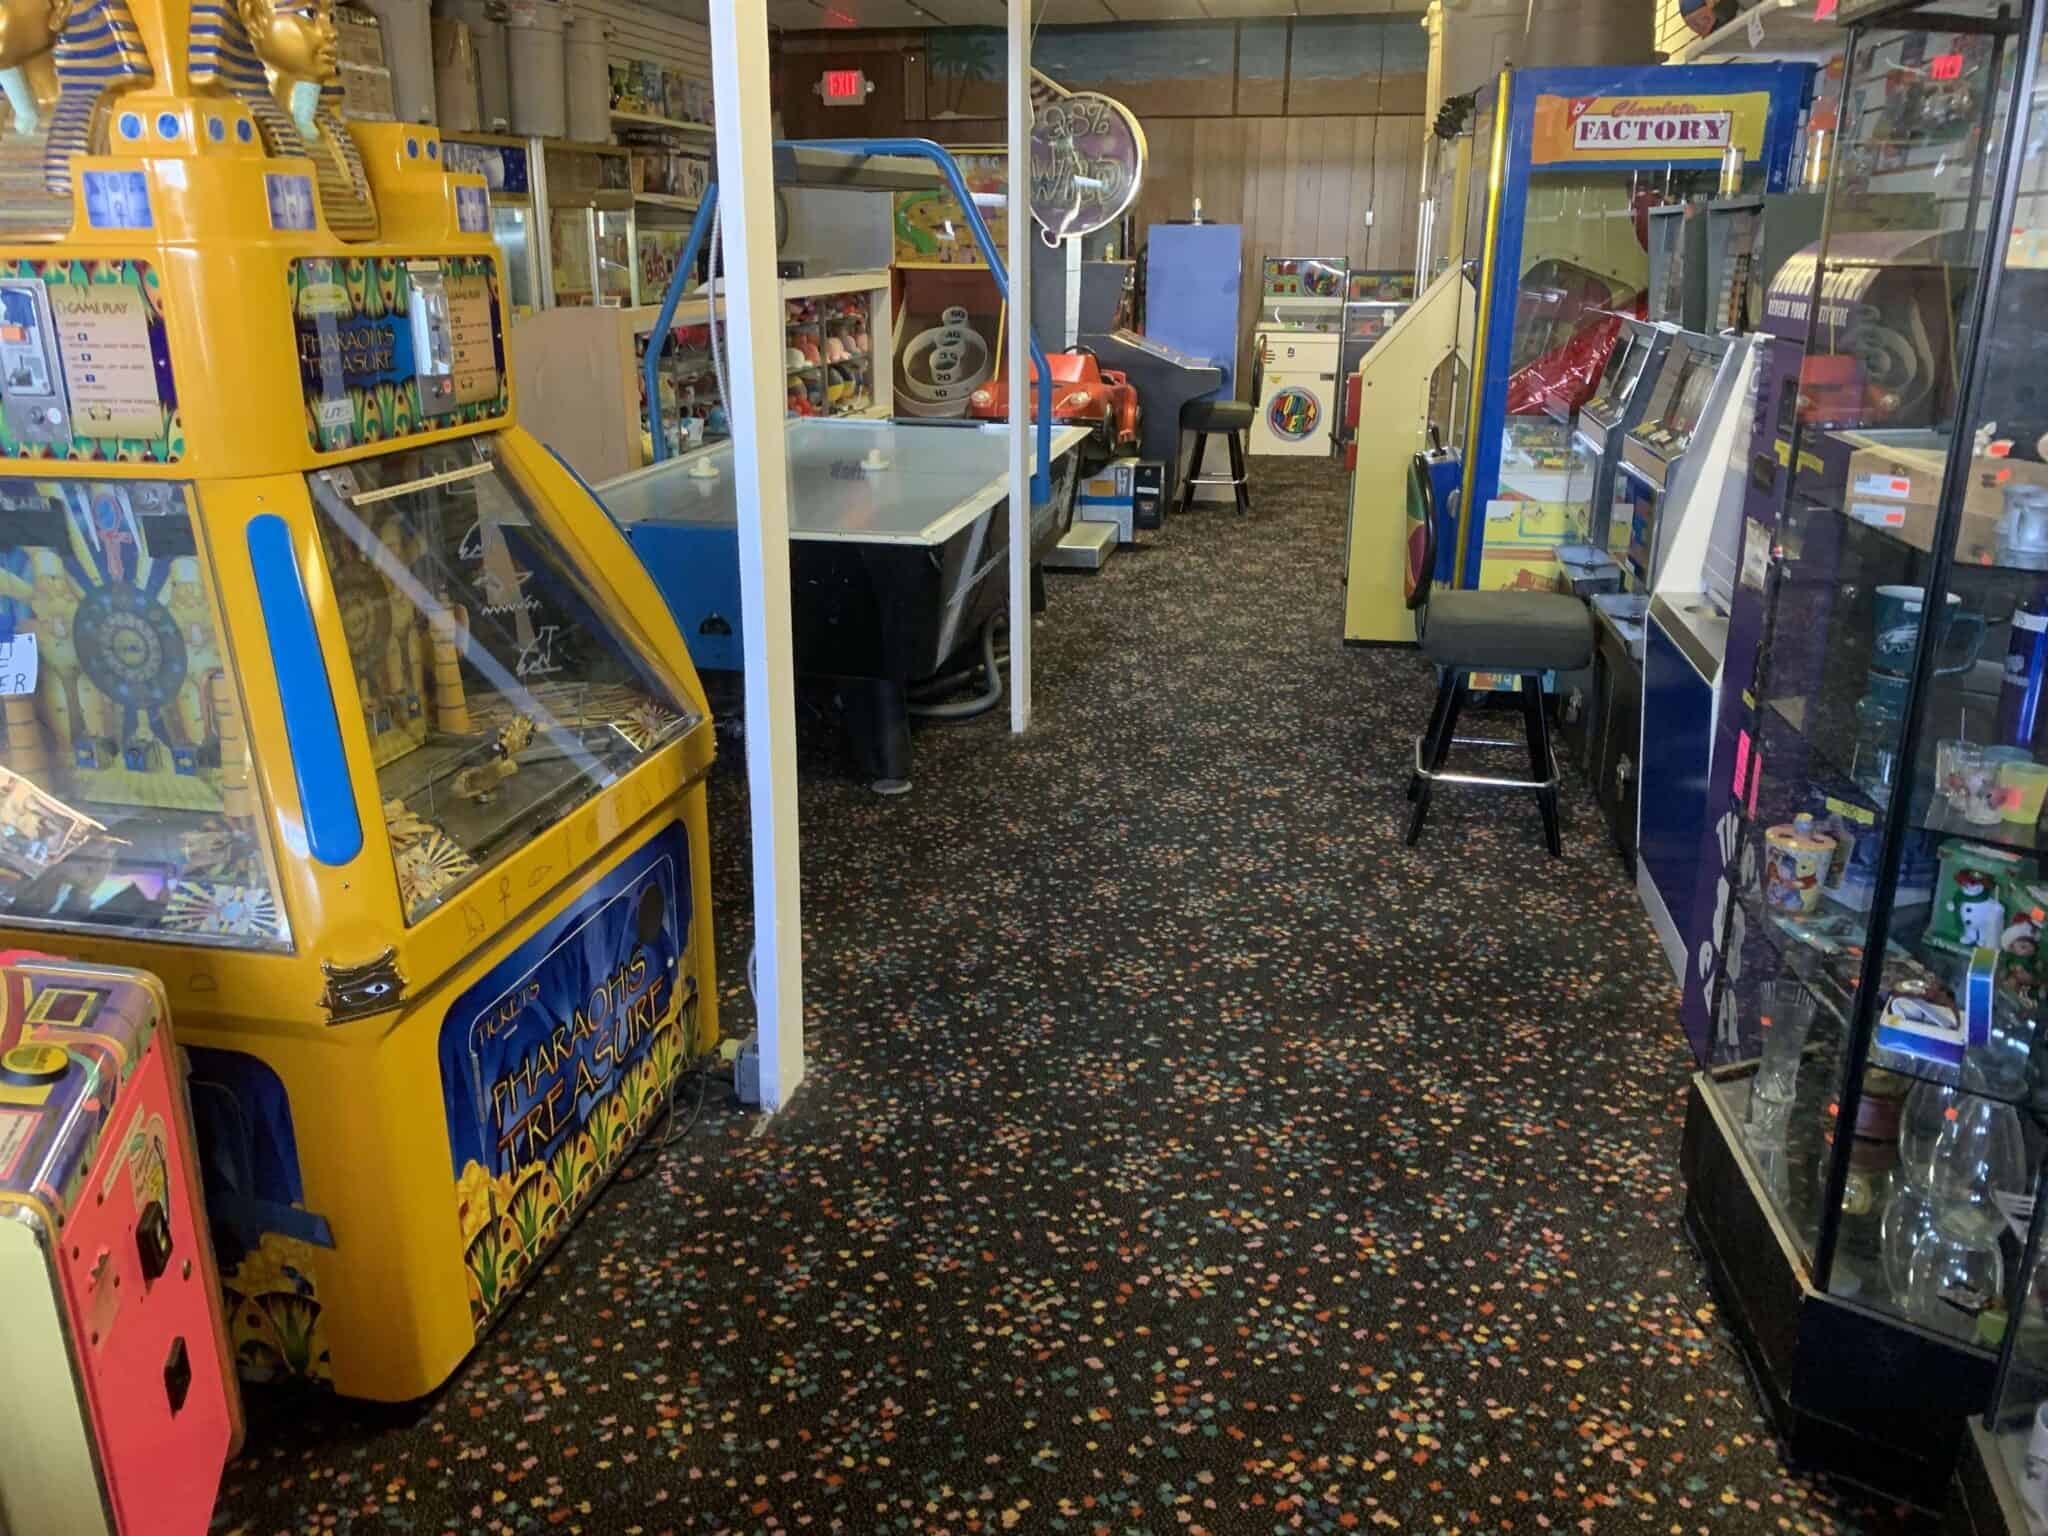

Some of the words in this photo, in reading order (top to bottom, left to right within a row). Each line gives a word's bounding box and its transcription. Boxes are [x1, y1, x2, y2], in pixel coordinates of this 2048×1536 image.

[828, 71, 857, 96] EXIT
[1579, 118, 1727, 142] FACTORY
[67, 301, 100, 315] GAME
[101, 301, 129, 314] PLAY
[935, 389, 948, 398] 10
[496, 973, 671, 1178] TREASURE
